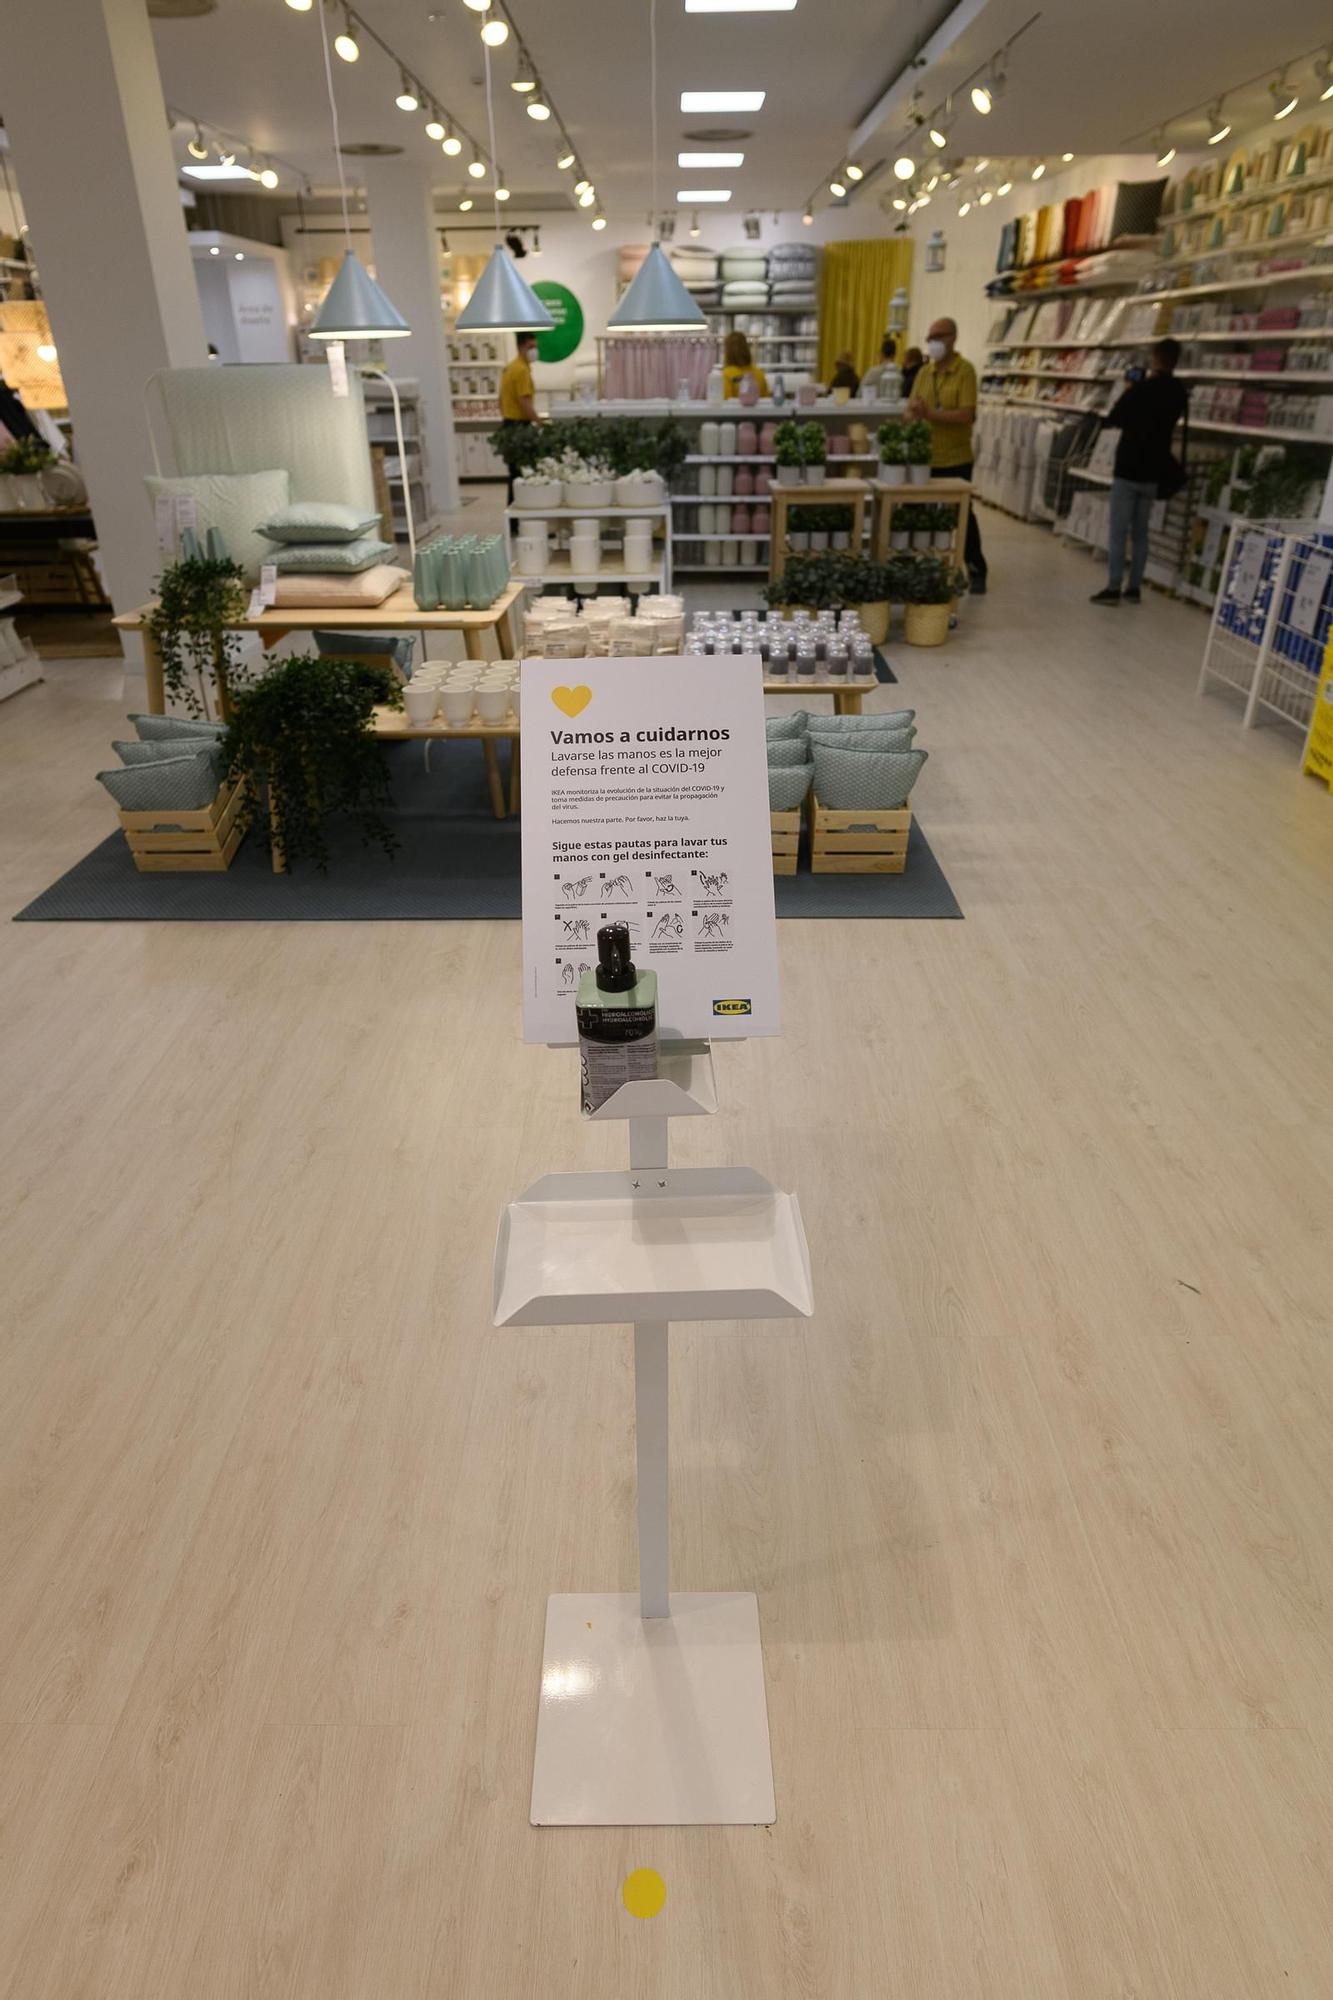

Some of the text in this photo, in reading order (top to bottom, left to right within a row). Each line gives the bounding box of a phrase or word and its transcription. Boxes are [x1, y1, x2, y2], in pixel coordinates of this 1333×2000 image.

[550, 727, 730, 744] Vamos a cuidarnos
[551, 747, 722, 761] Lavarse las manos es la mejor
[551, 762, 705, 777] defensa frente al COVID-19
[680, 793, 718, 801] propagación
[552, 837, 728, 852] Sigue estas pautas para lavar tus
[552, 850, 709, 863] manos con gel desinfectante:
